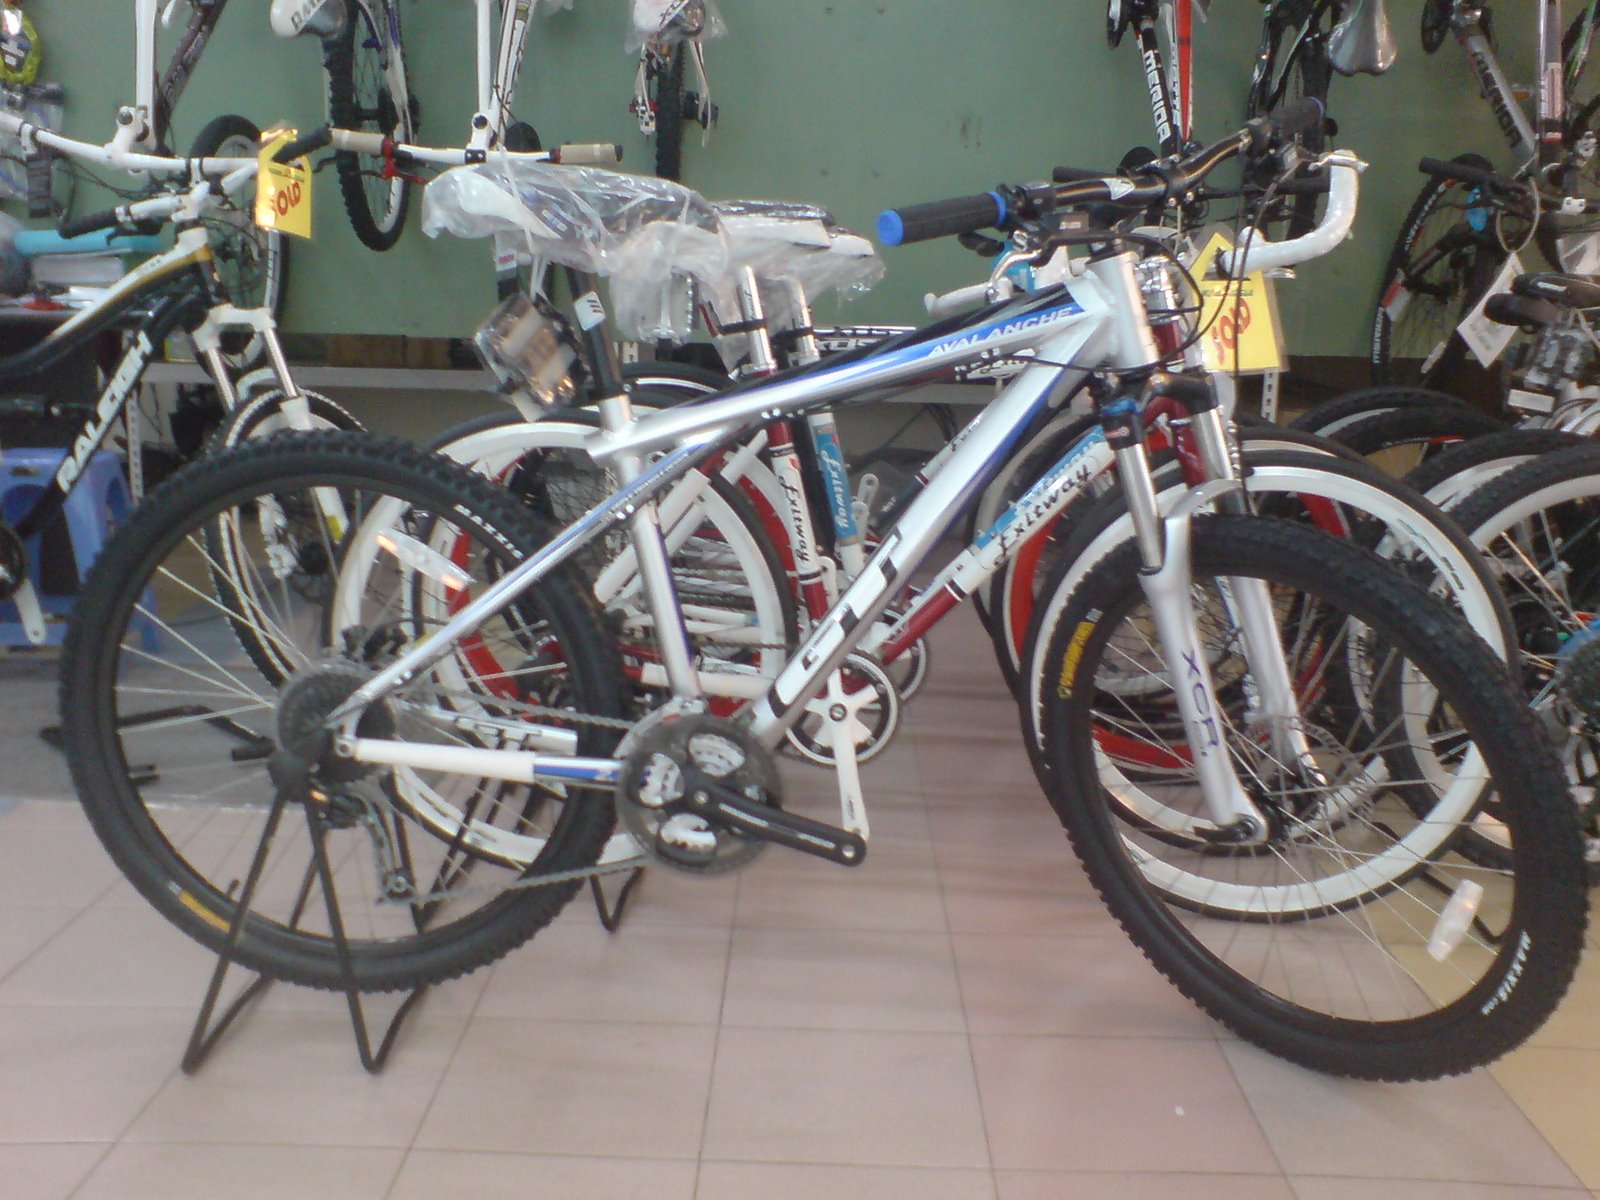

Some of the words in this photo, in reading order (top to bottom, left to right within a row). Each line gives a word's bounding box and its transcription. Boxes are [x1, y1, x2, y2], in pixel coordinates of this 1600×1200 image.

[1144, 50, 1172, 145] MERIDA
[926, 306, 1074, 358] AVALANCHE
[778, 474, 810, 563] Exitway
[993, 463, 1093, 567] Exitway
[769, 526, 903, 718] GT
